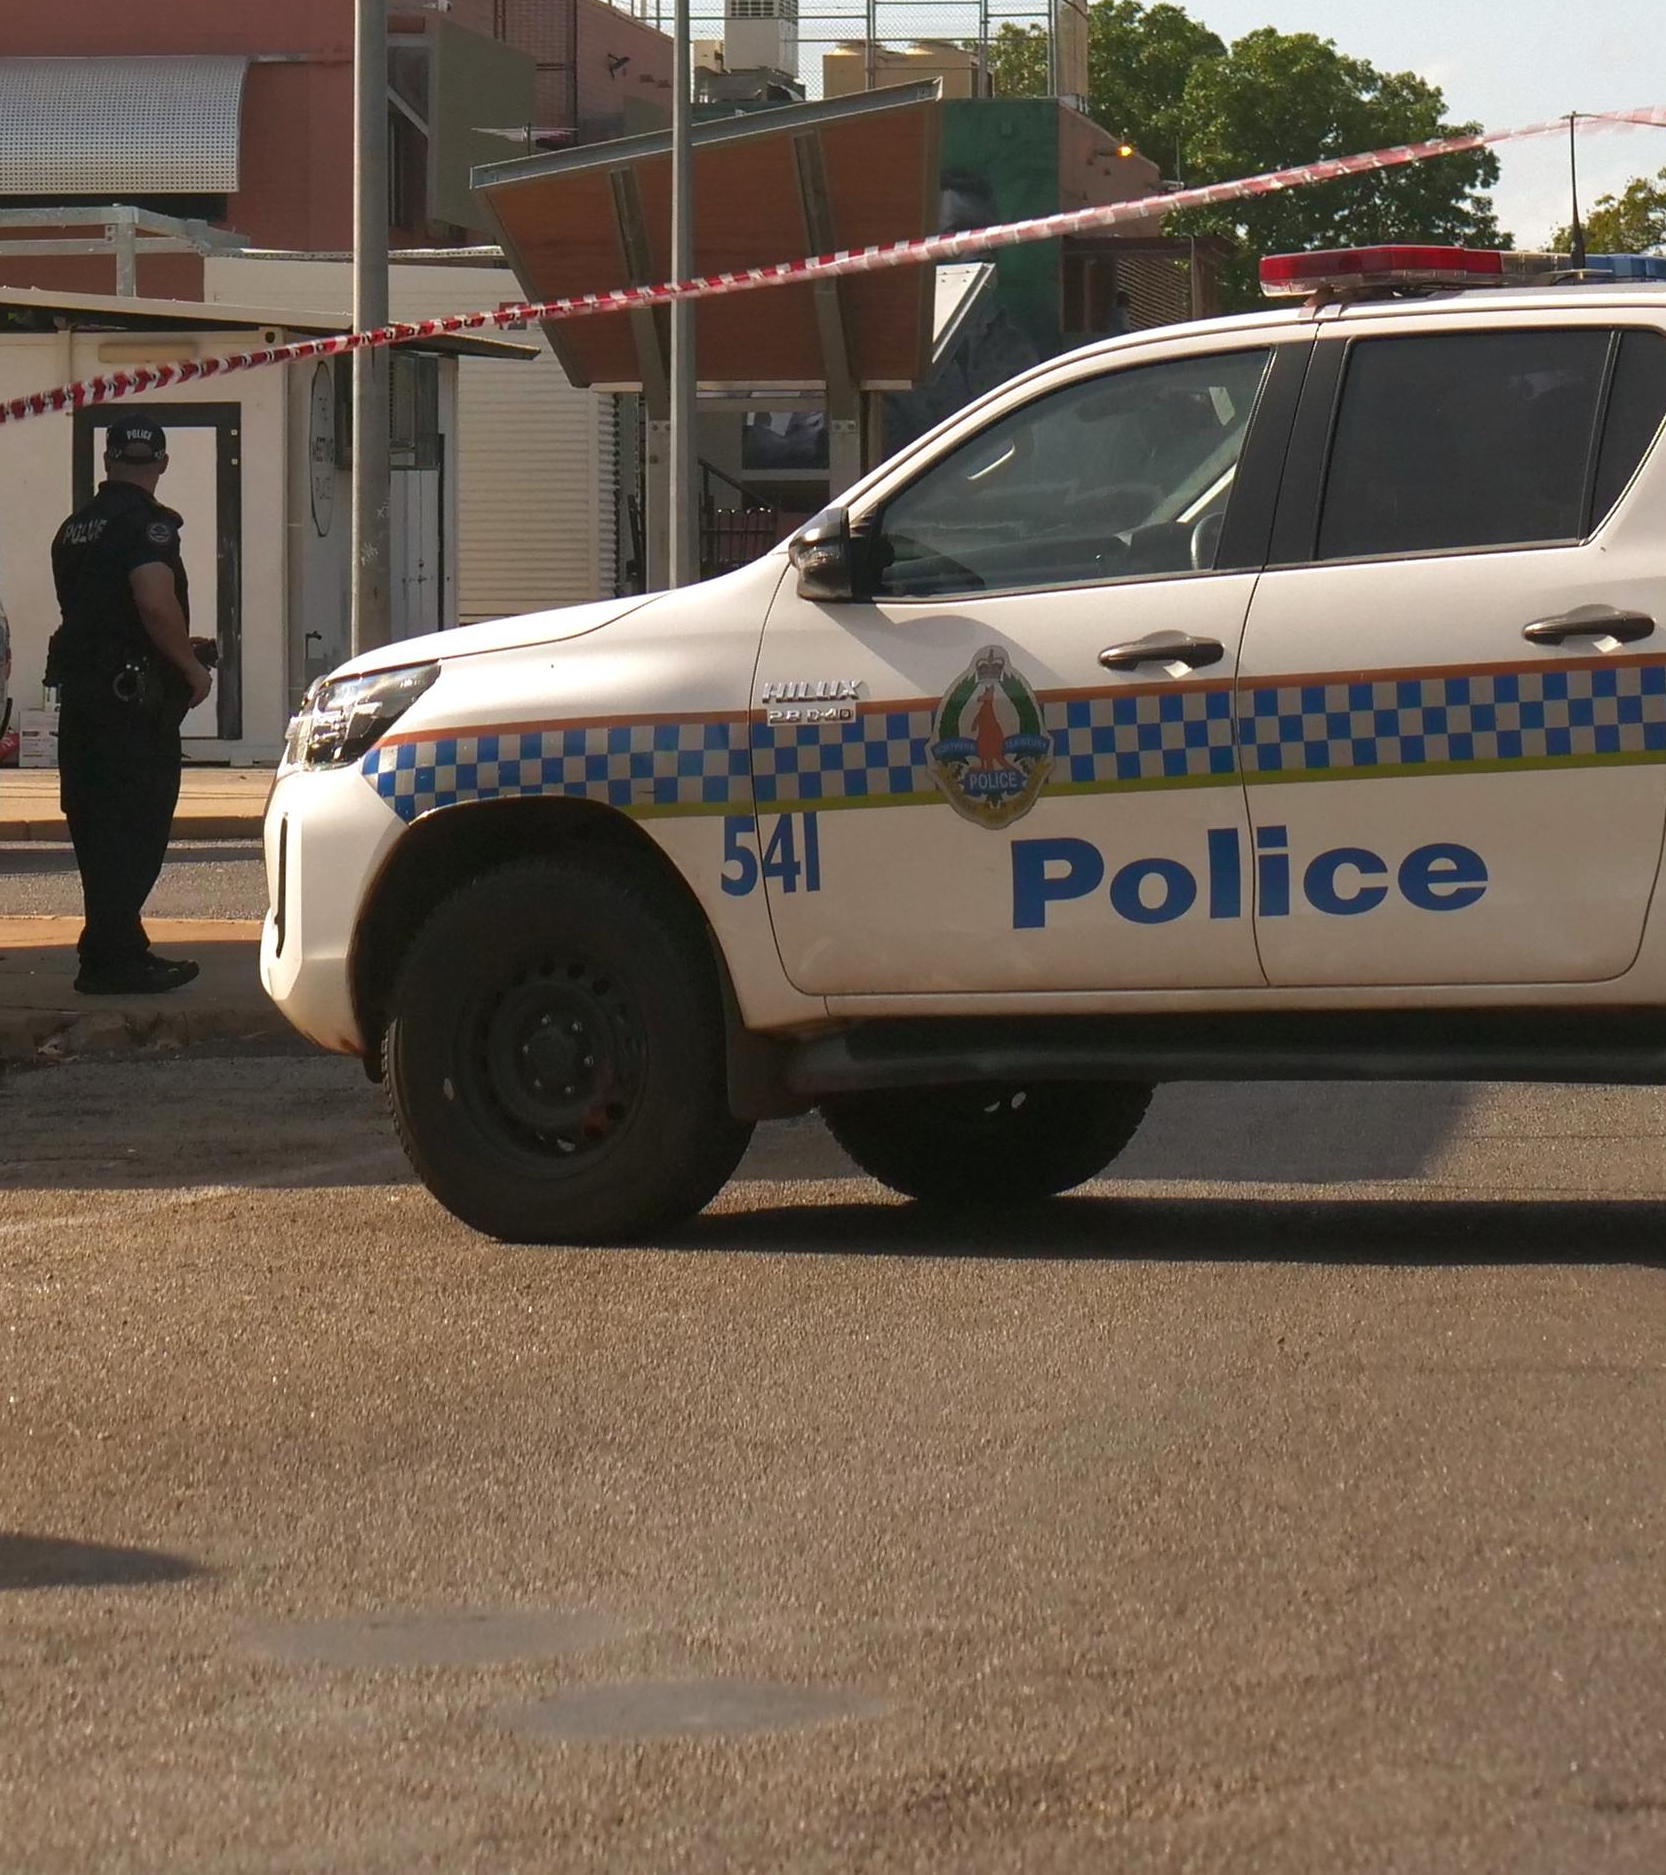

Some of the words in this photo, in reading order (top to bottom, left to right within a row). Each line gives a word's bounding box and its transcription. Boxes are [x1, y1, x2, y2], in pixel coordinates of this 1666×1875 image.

[126, 428, 153, 441] POLICE
[762, 680, 864, 703] HILUX
[969, 772, 1017, 790] POLICE
[721, 811, 821, 897] 541
[1011, 825, 1489, 930] Police
